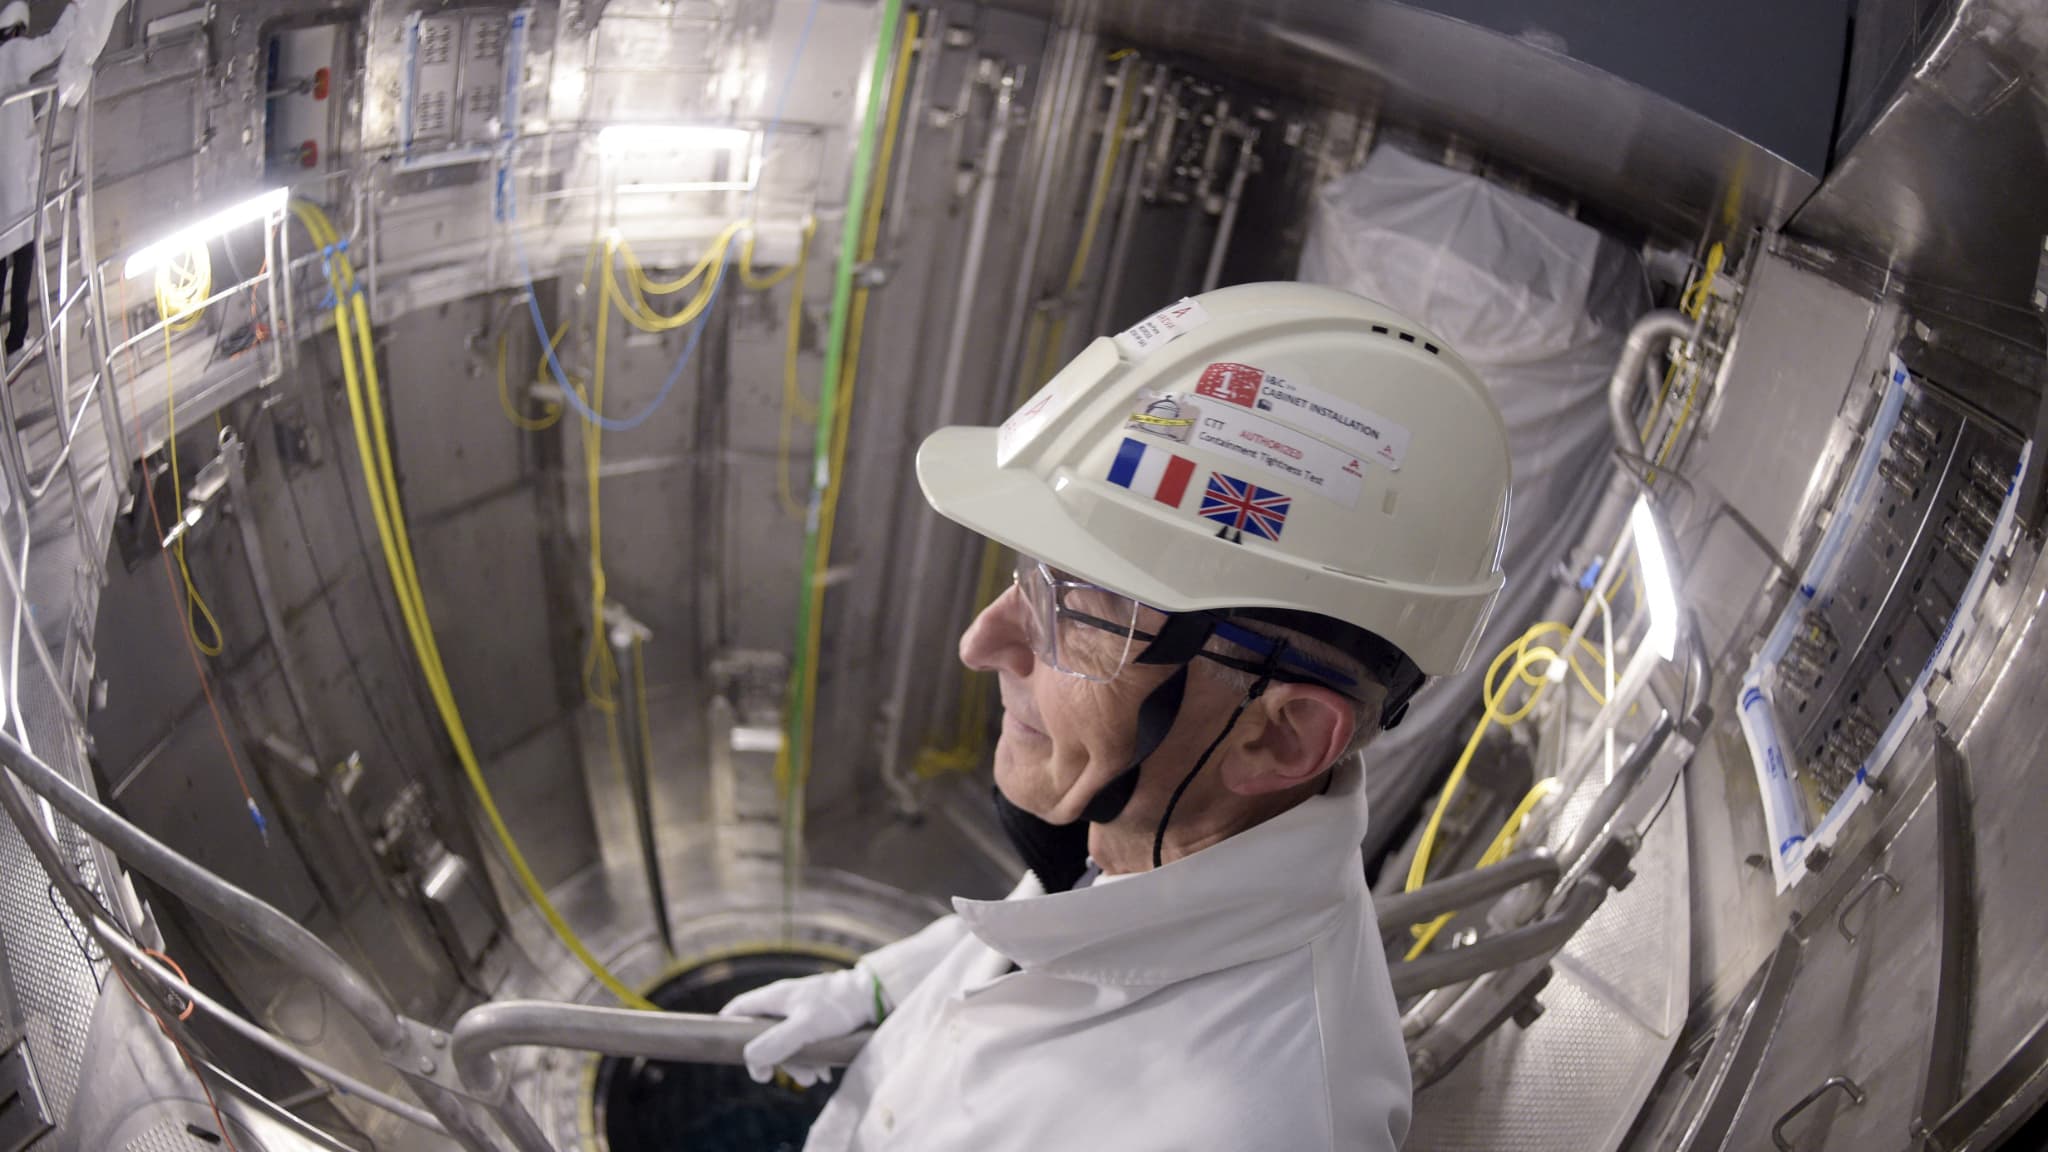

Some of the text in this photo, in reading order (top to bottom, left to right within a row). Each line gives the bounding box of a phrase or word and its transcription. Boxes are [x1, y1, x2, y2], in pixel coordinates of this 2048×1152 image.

[1204, 417, 1227, 430] CTT
[1240, 430, 1303, 460] AUTHORIZED
[1262, 386, 1380, 440] CABINET INSTALLATION
[1199, 431, 1258, 458] Containment
[1260, 451, 1303, 476] Tightness
[1304, 470, 1325, 486] Test
